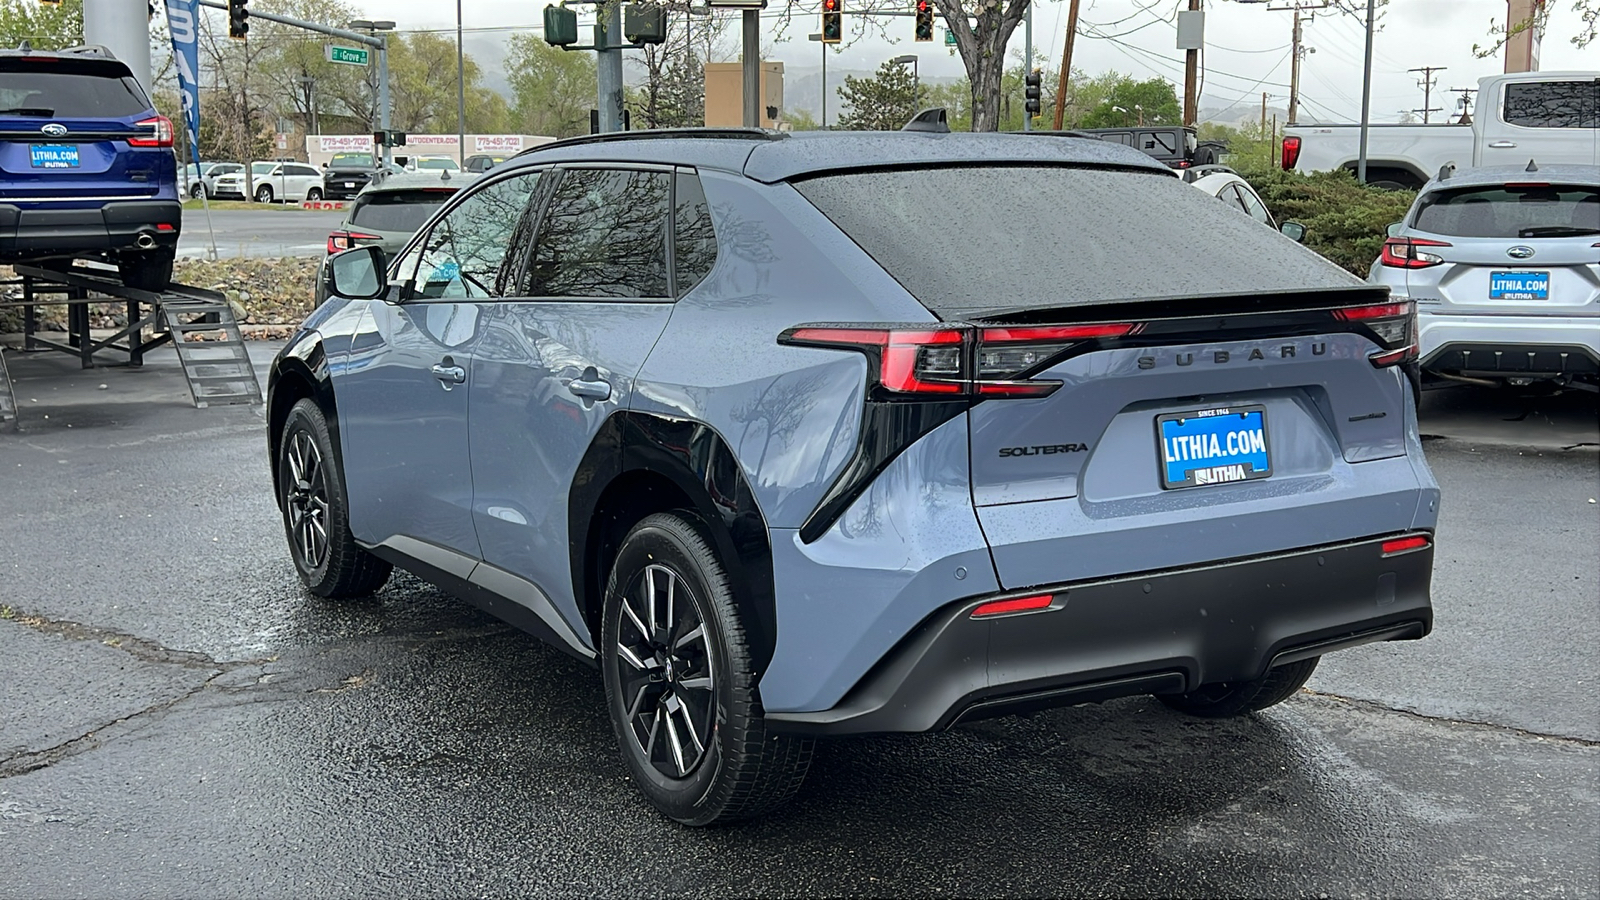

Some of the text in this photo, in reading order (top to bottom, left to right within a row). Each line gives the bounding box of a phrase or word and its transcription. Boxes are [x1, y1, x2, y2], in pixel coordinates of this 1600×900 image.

[342, 50, 360, 62] Grove
[322, 137, 370, 146] 775-451-7021
[407, 137, 459, 145] AUTOCENTER.COM
[477, 137, 520, 146] 775-451-7021
[32, 151, 78, 160] LITHIA.COM
[1492, 281, 1547, 291] LITHIA.COM
[1138, 343, 1326, 370] SUBARU
[1198, 409, 1215, 417] SINCE
[999, 443, 1089, 458] SOLTERRA
[1164, 429, 1265, 462] LITHIA.COM
[1207, 464, 1246, 483] LITHIA
